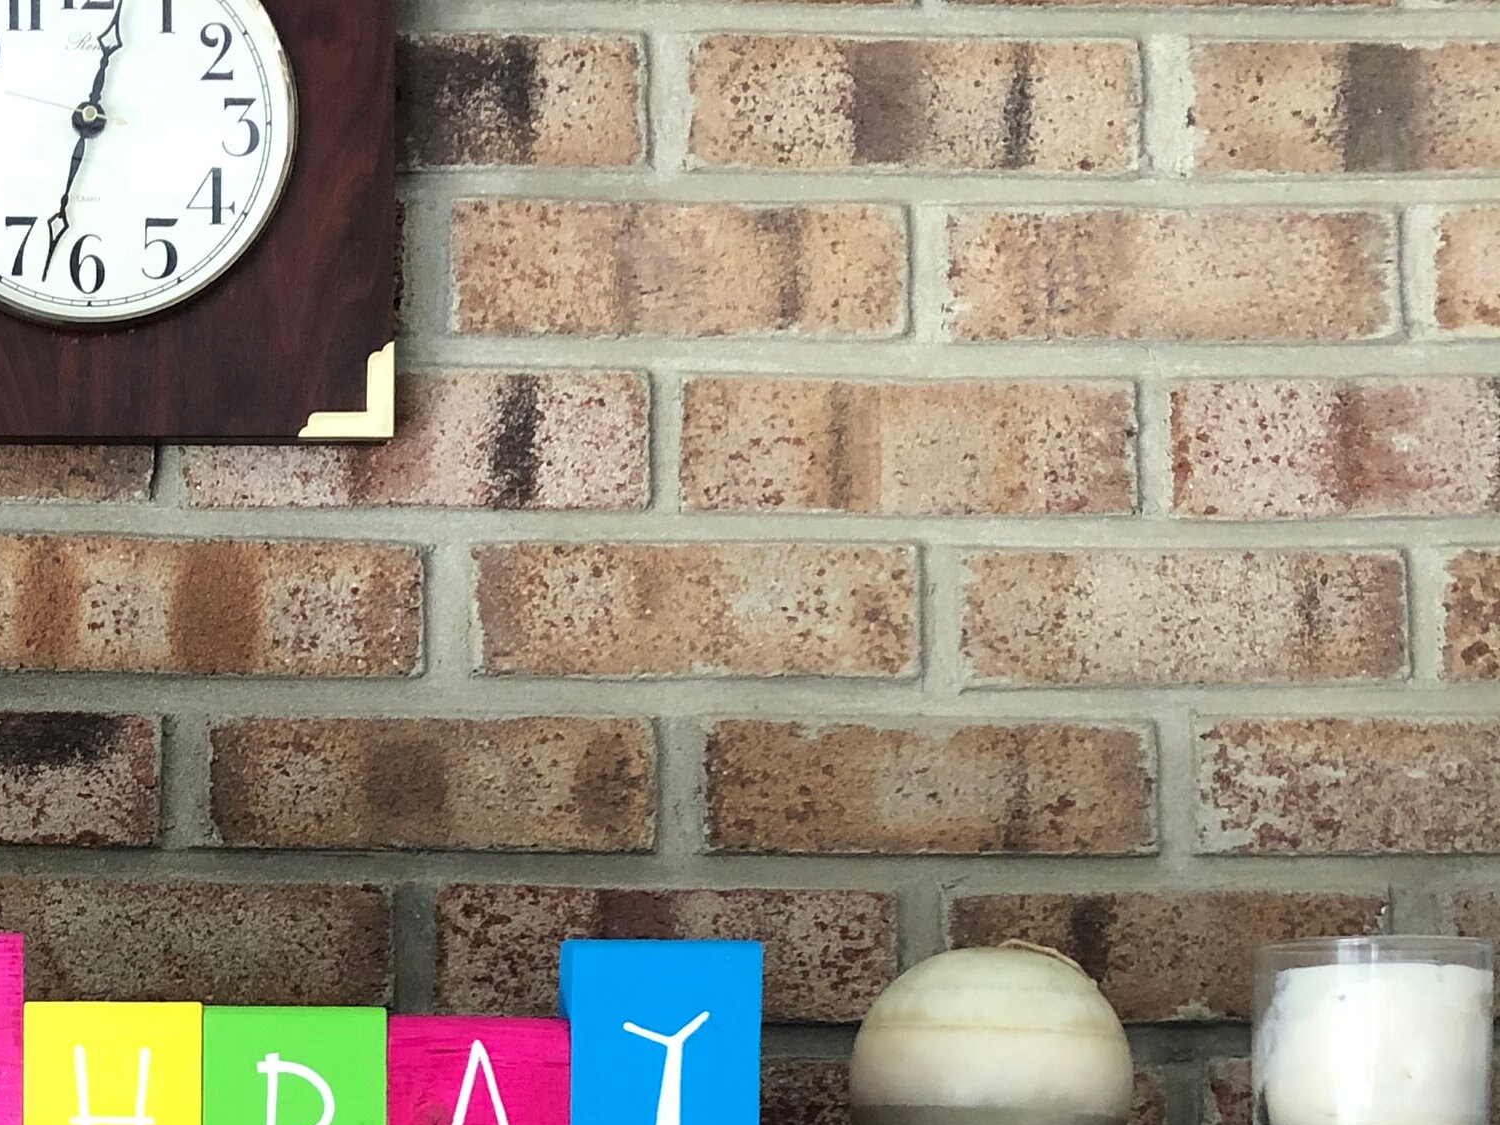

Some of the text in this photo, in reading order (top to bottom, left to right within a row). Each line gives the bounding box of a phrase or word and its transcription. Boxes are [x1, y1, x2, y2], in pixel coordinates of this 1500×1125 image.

[199, 22, 234, 81] 2
[222, 97, 260, 156] 3
[186, 167, 236, 226] 4
[5, 216, 38, 277] 7
[69, 234, 106, 295] 6
[141, 217, 179, 280] 5
